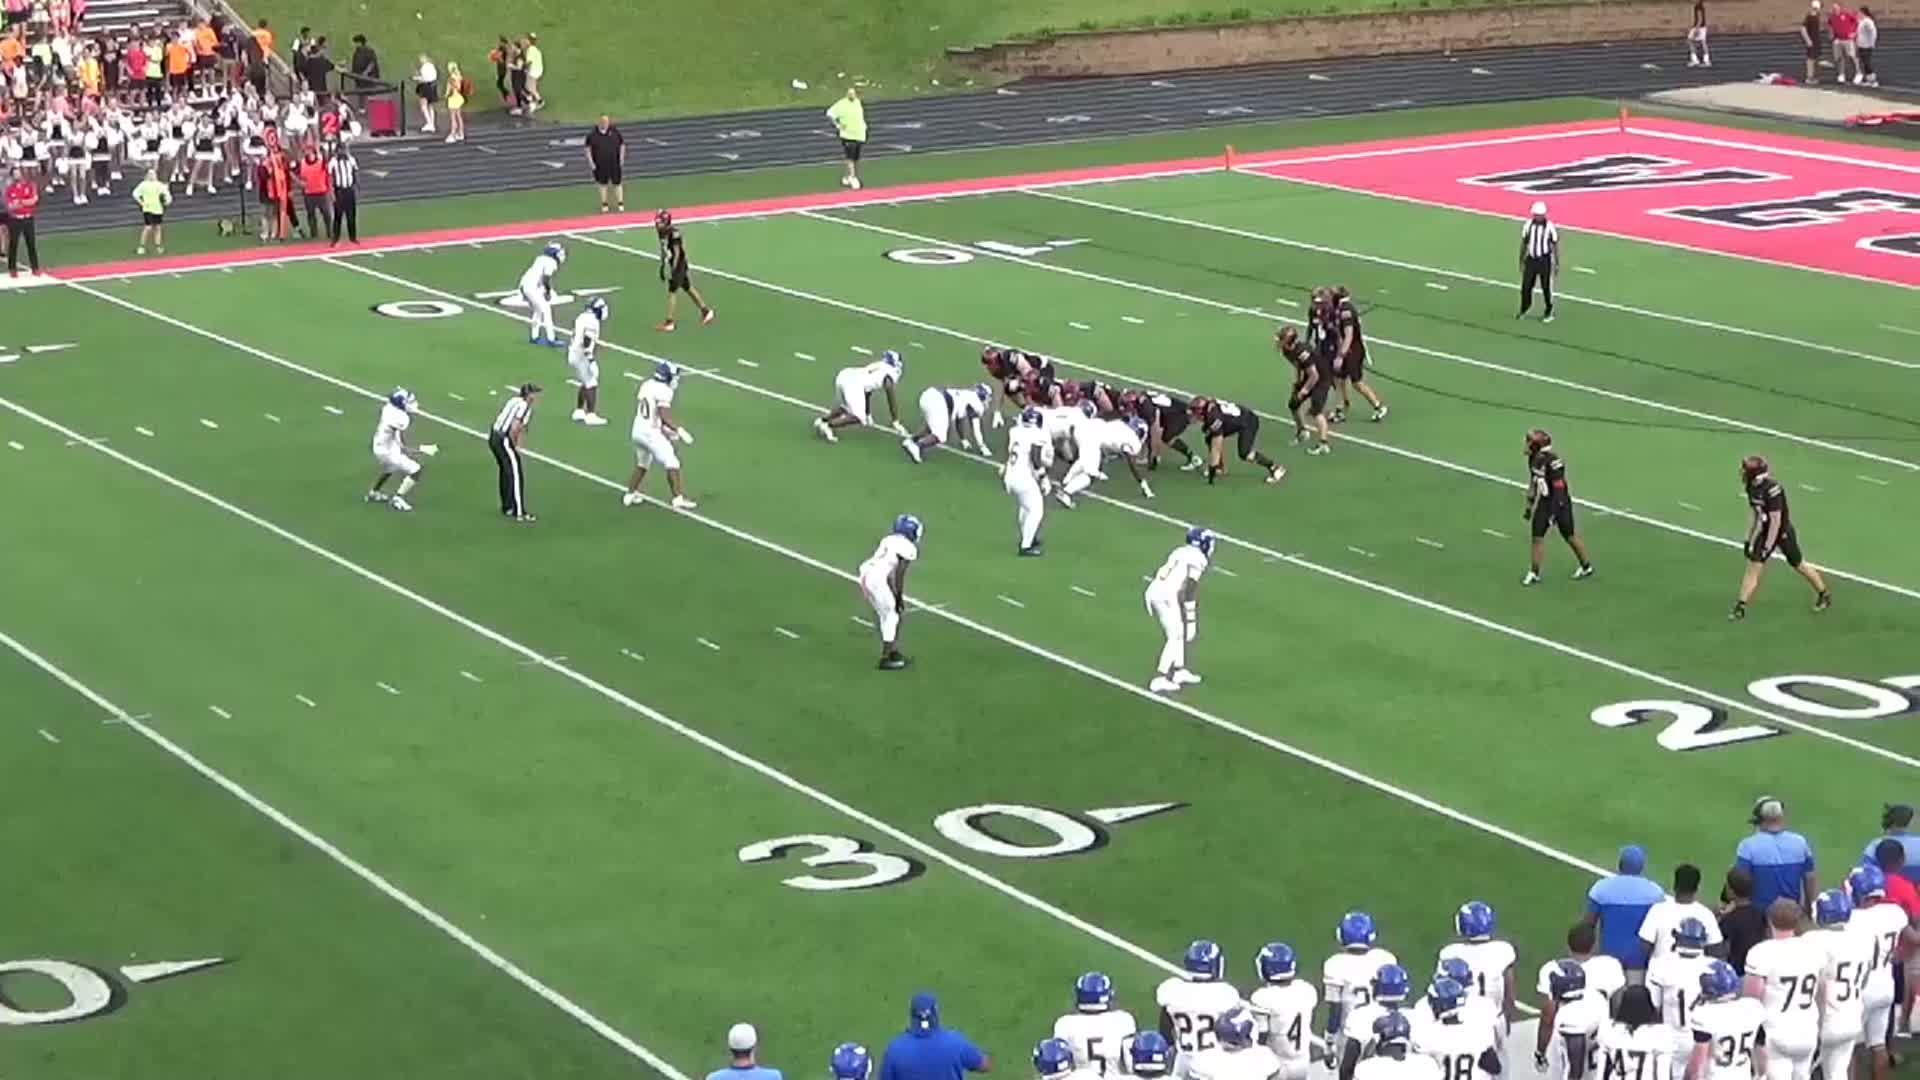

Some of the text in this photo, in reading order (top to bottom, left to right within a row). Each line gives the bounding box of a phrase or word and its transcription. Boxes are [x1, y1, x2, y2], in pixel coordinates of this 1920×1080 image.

[1457, 154, 1920, 257] WE
[738, 804, 1098, 889] 30
[1779, 973, 1817, 1013] 79
[1174, 1012, 1215, 1051] 22
[1287, 1012, 1302, 1051] 4
[1716, 1032, 1753, 1067] 35
[1087, 1036, 1107, 1079] 5
